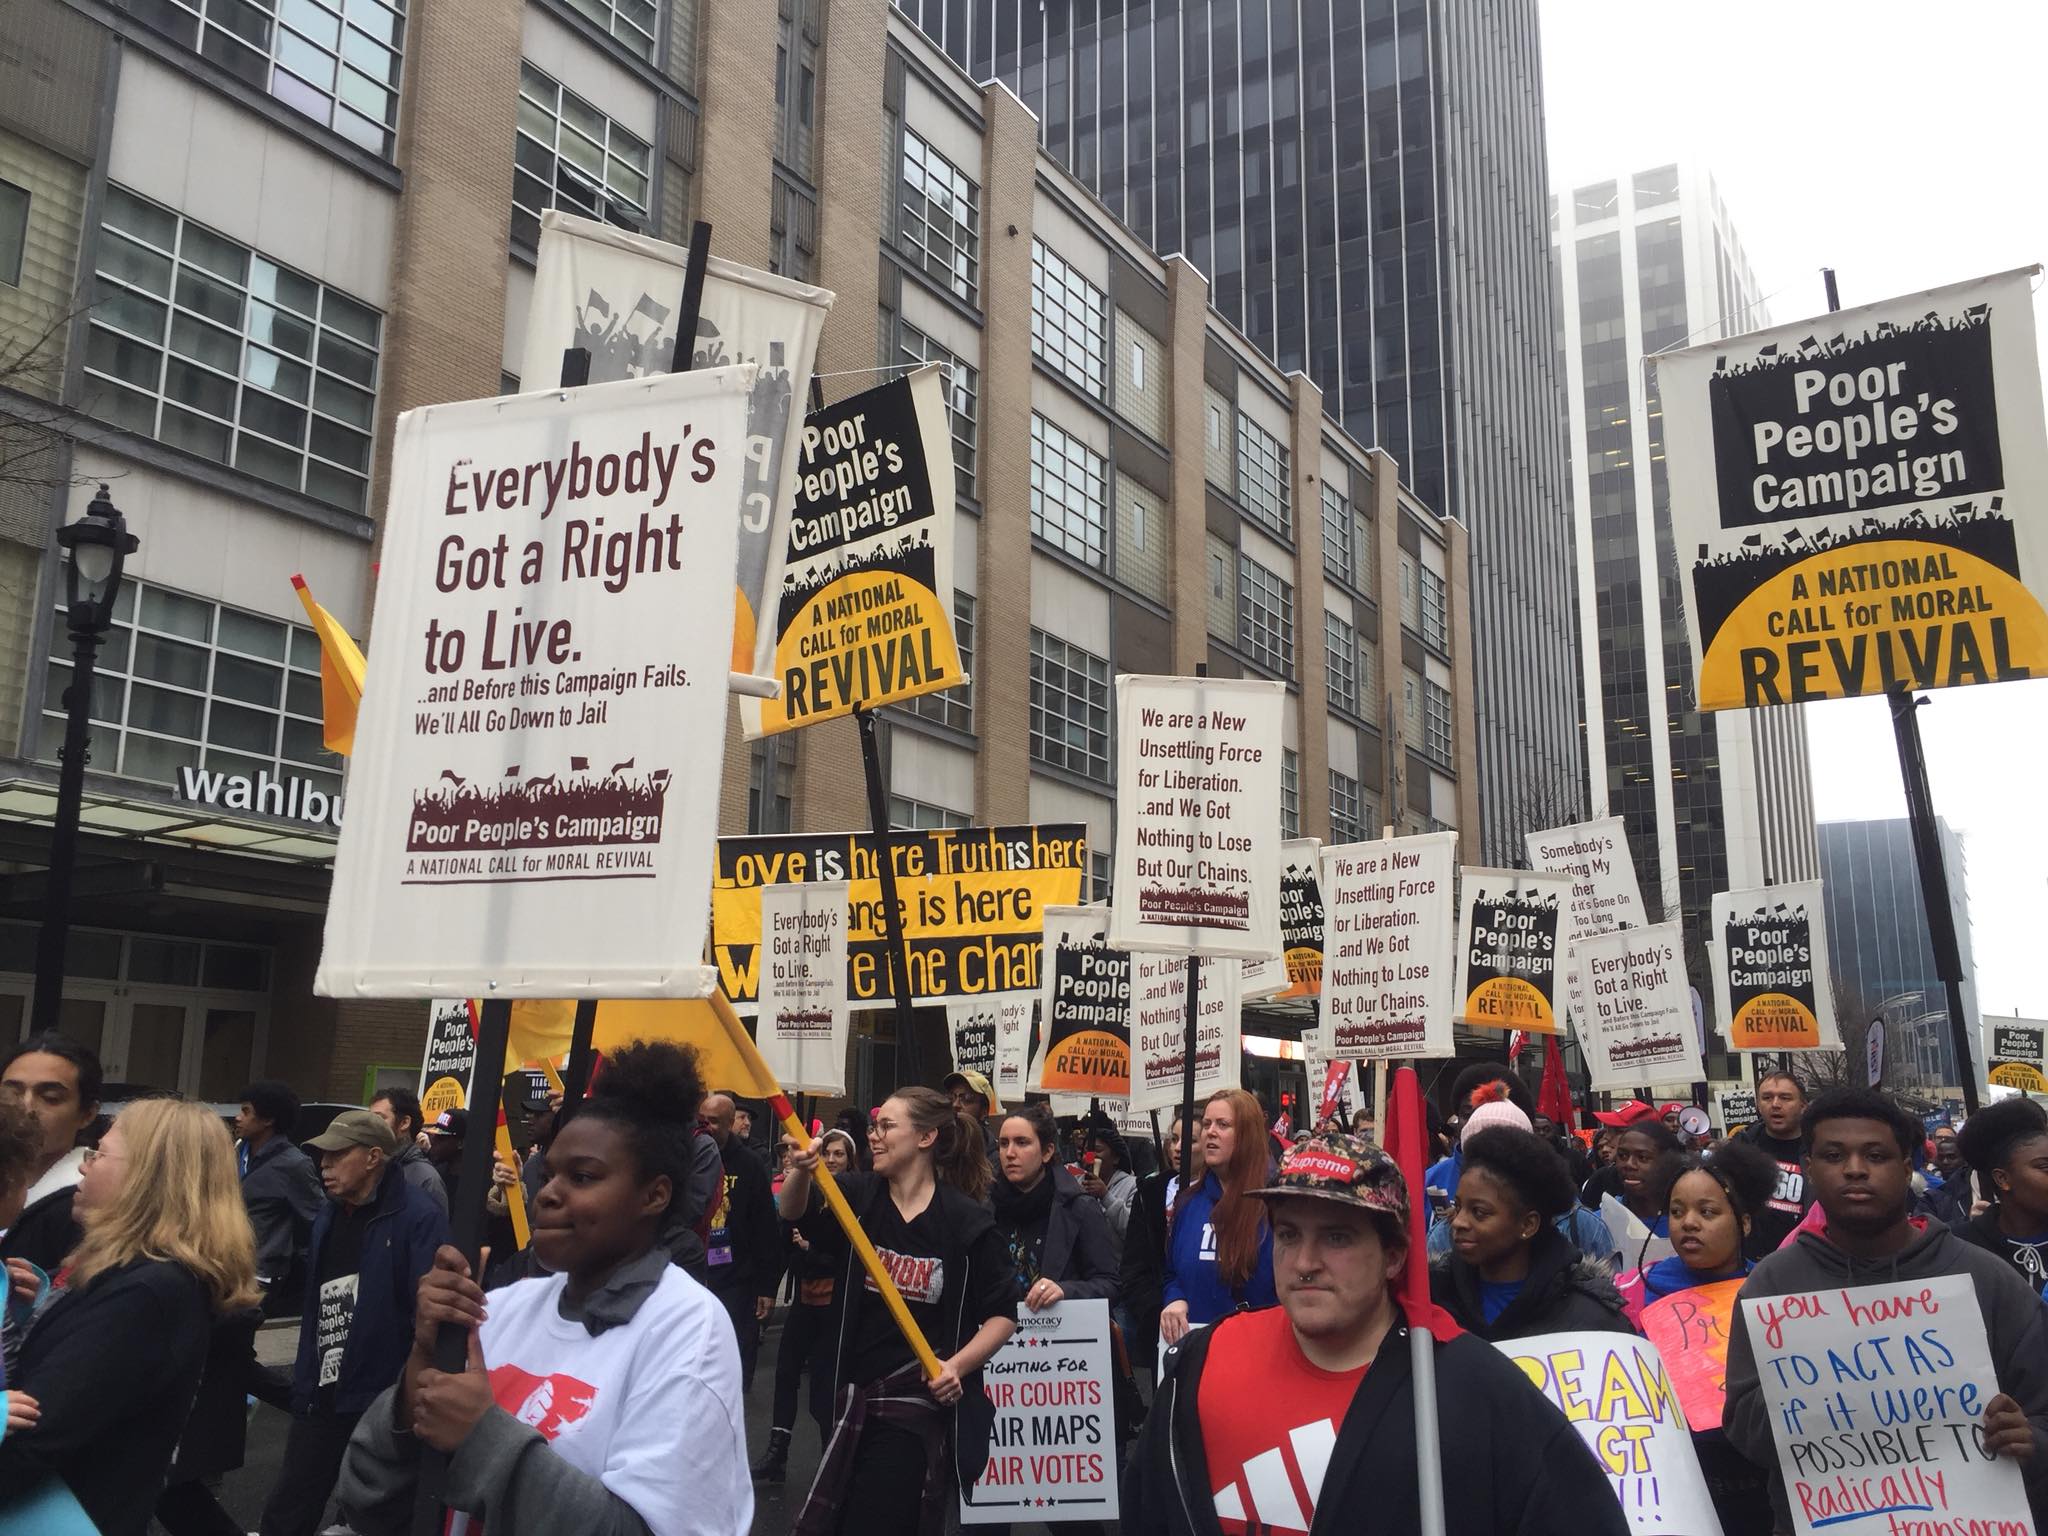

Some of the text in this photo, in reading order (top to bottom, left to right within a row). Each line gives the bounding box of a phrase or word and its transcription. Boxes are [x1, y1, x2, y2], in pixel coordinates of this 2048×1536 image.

[1794, 360, 1906, 414] Poor
[801, 413, 866, 464] Poor
[1753, 392, 1959, 465] People's
[445, 423, 716, 520] Everybody's
[1752, 447, 1966, 513] Campaign
[790, 483, 913, 552] Campaign
[435, 513, 683, 593] Got a Right
[1791, 552, 1957, 601] A NATIONAL
[812, 578, 905, 627] A NATIONAL
[1767, 585, 1993, 638] CALL for MORAL
[425, 607, 582, 674] to Live.
[800, 603, 923, 658] CALL for MORAL
[785, 627, 944, 720] REVIVAL
[1740, 616, 2030, 709] REVIVAL
[463, 678, 515, 702] Before
[520, 674, 550, 696] this
[555, 669, 637, 698] Campaign
[643, 664, 691, 688] Fails.
[415, 702, 607, 736] We'll All Go Down to Jail
[1141, 708, 1246, 731] We are a New
[1140, 738, 1262, 765] Unsettling Force
[1138, 769, 1243, 793] for Liberation.
[1180, 799, 1200, 818] We
[1206, 800, 1231, 820] Got
[411, 812, 659, 846] Poor People's Campaign
[1137, 827, 1251, 853] Nothing to Lose
[713, 842, 807, 888] Love
[815, 849, 844, 881] is
[928, 828, 1007, 875] Truth
[1007, 841, 1031, 870] is
[1540, 837, 1613, 860] Somebody's
[407, 850, 654, 876] A NATIONAL CALL for MORAL REVIVAL
[1137, 858, 1251, 883] But Our Chains.
[1335, 851, 1420, 877] We are New
[1592, 859, 1611, 875] My
[1399, 879, 1435, 898] Force
[919, 880, 1031, 927] is here
[1141, 899, 1248, 917] Poor People's Campaign
[1593, 894, 1631, 909] Gone On
[774, 908, 837, 934] Everybody's
[1354, 909, 1420, 931] Liberation.
[1493, 910, 1537, 930] Poor
[1573, 913, 1614, 926] Too Long
[773, 934, 831, 958] Got Right
[1366, 934, 1409, 955] We Got
[1474, 926, 1552, 950] People's
[1747, 928, 1789, 946] Poor
[1081, 953, 1129, 977] Poor
[1470, 949, 1553, 975] Campaign
[1591, 946, 1672, 976] Everybody's
[1731, 945, 1809, 967] People's
[773, 959, 813, 979] to Live.
[1140, 961, 1156, 979] for
[1332, 963, 1429, 988] Nothing to Lose
[1730, 967, 1812, 988] Campaign
[1169, 979, 1184, 995] We
[1594, 968, 1668, 996] Got Right
[1140, 1000, 1224, 1027] Nothing Lose
[1332, 991, 1429, 1015] But Our Chains.
[1478, 997, 1542, 1019] REVIVAL
[1597, 995, 1648, 1017] to Live.
[444, 1022, 467, 1038] Poor
[1386, 1030, 1425, 1041] Campaign
[1745, 1015, 1808, 1033] REVIVAL
[2009, 1031, 2030, 1041] Poor
[432, 1036, 474, 1055] People's
[965, 1032, 985, 1044] Poor
[1082, 1037, 1117, 1048] NATIONAL
[1141, 1031, 1180, 1051] But Our
[2000, 1038, 2038, 1050] People's
[958, 1042, 995, 1060] People's
[1100, 1048, 1125, 1058] MORAL
[2000, 1047, 2039, 1058] Campaign
[428, 1054, 472, 1073] Campaign
[1056, 1055, 1130, 1079] REVIVAL
[1996, 1075, 2040, 1091] REVIVAL
[427, 1096, 458, 1110] REVIVAL
[1724, 1107, 1757, 1117] People's
[1730, 1099, 1749, 1109] Poor
[1757, 1295, 1830, 1349] you
[1841, 1288, 1939, 1327] have
[1057, 1357, 1089, 1372] FOR
[1767, 1330, 1954, 1388] TO ACT AS
[1021, 1380, 1101, 1408] COURTS
[1780, 1397, 1807, 1434] if
[1824, 1392, 1857, 1431] it
[1032, 1414, 1102, 1447] MAPS
[1791, 1424, 1939, 1478] POSSIBLE
[1029, 1453, 1104, 1485] VOTES
